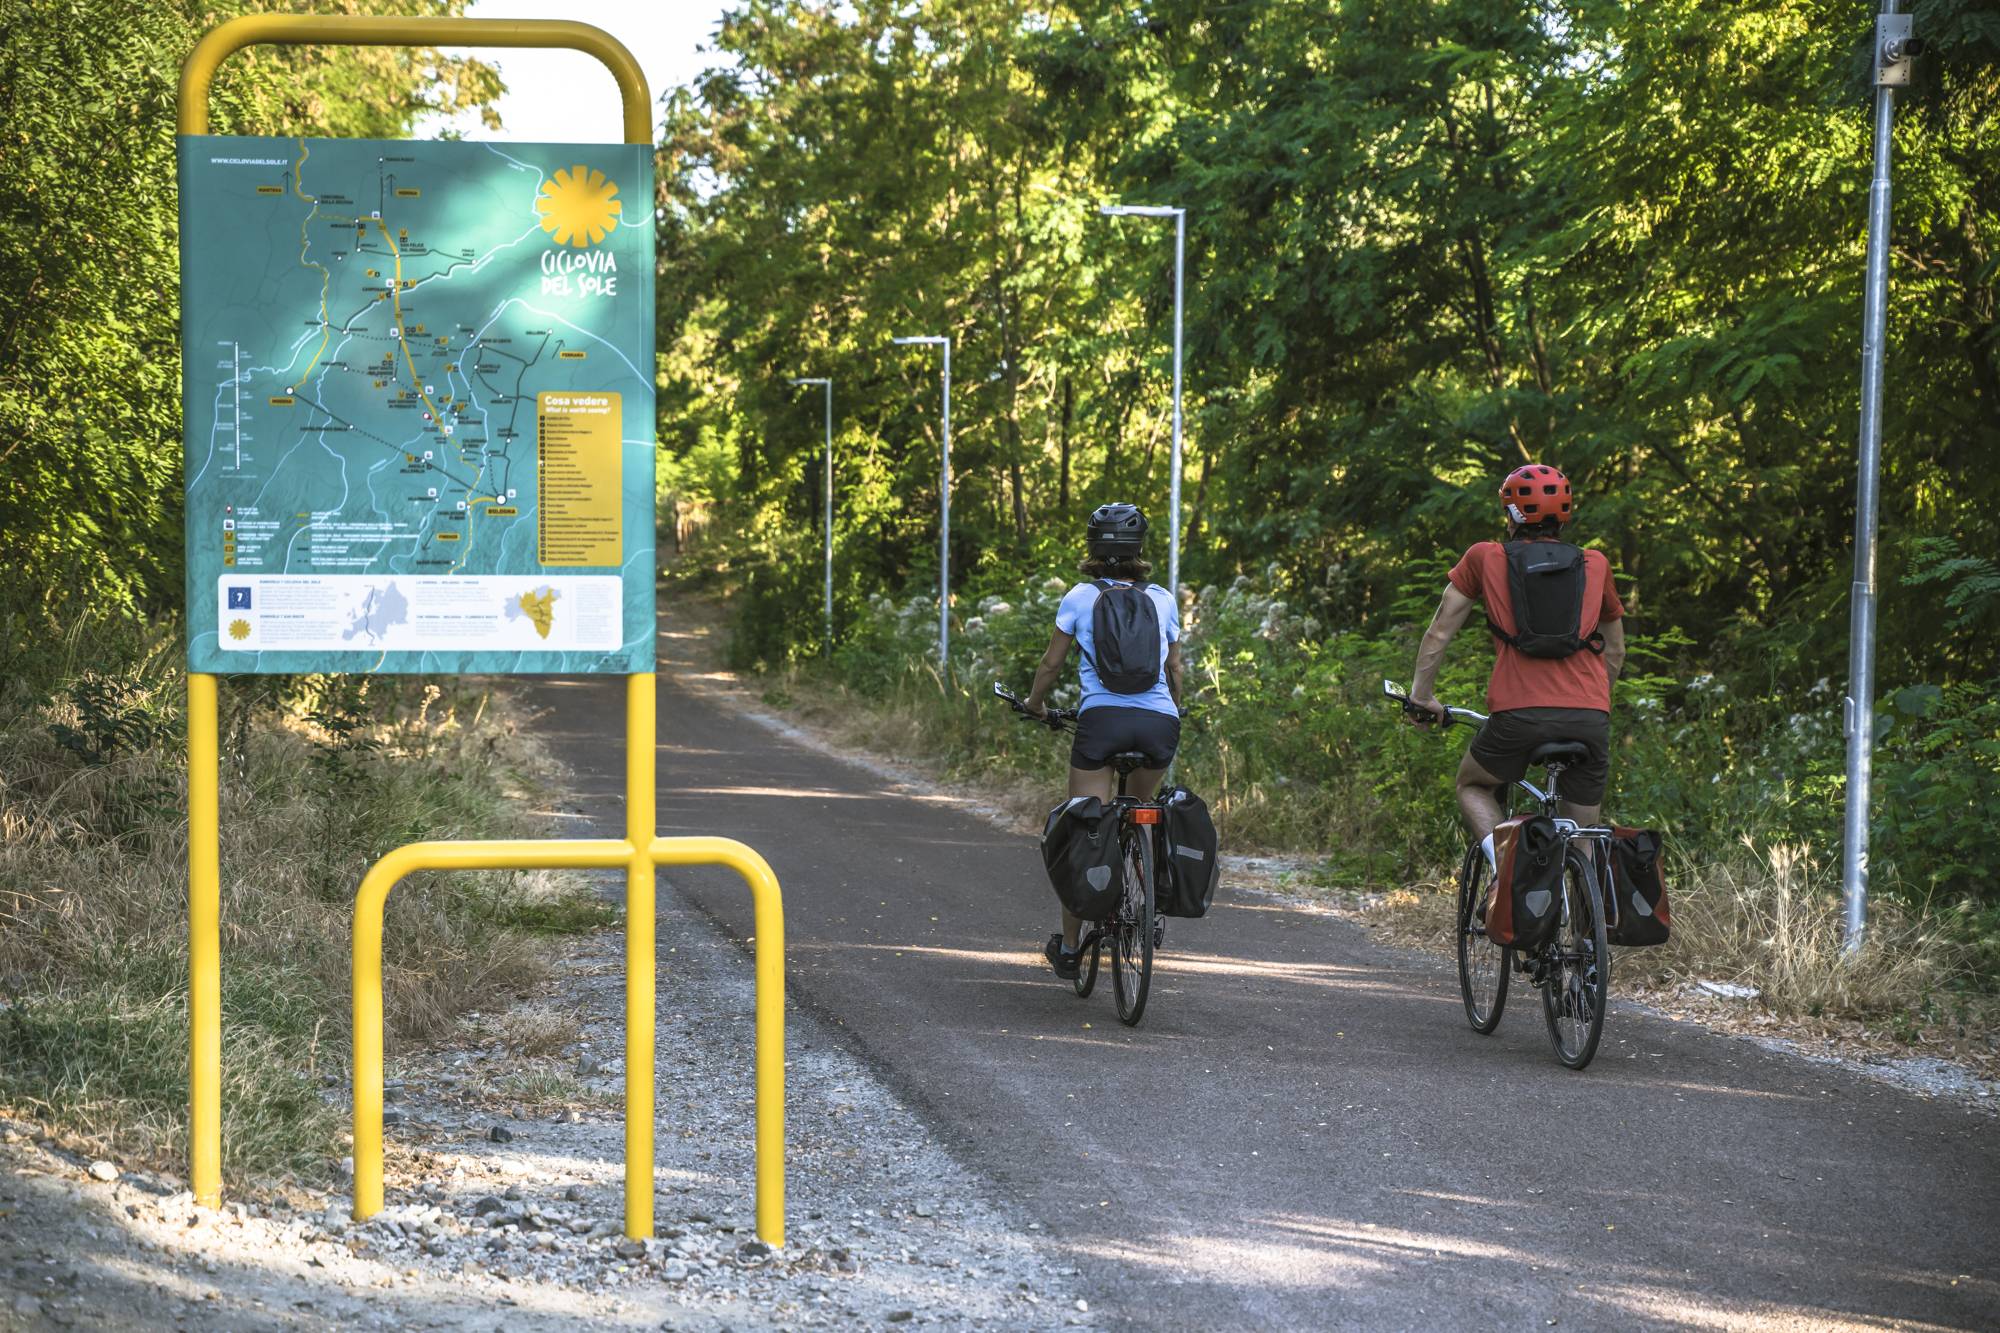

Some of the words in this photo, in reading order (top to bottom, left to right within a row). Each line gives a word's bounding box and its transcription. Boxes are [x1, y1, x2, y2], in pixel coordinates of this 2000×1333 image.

[210, 158, 288, 166] WWW.CICLOVIADELSOLE.IT
[541, 249, 617, 275] CICLOVIA
[541, 275, 573, 297] DEL
[577, 272, 617, 299] SOLE
[544, 395, 570, 406] Cosa
[572, 395, 609, 406] vedere
[236, 593, 243, 602] 7
